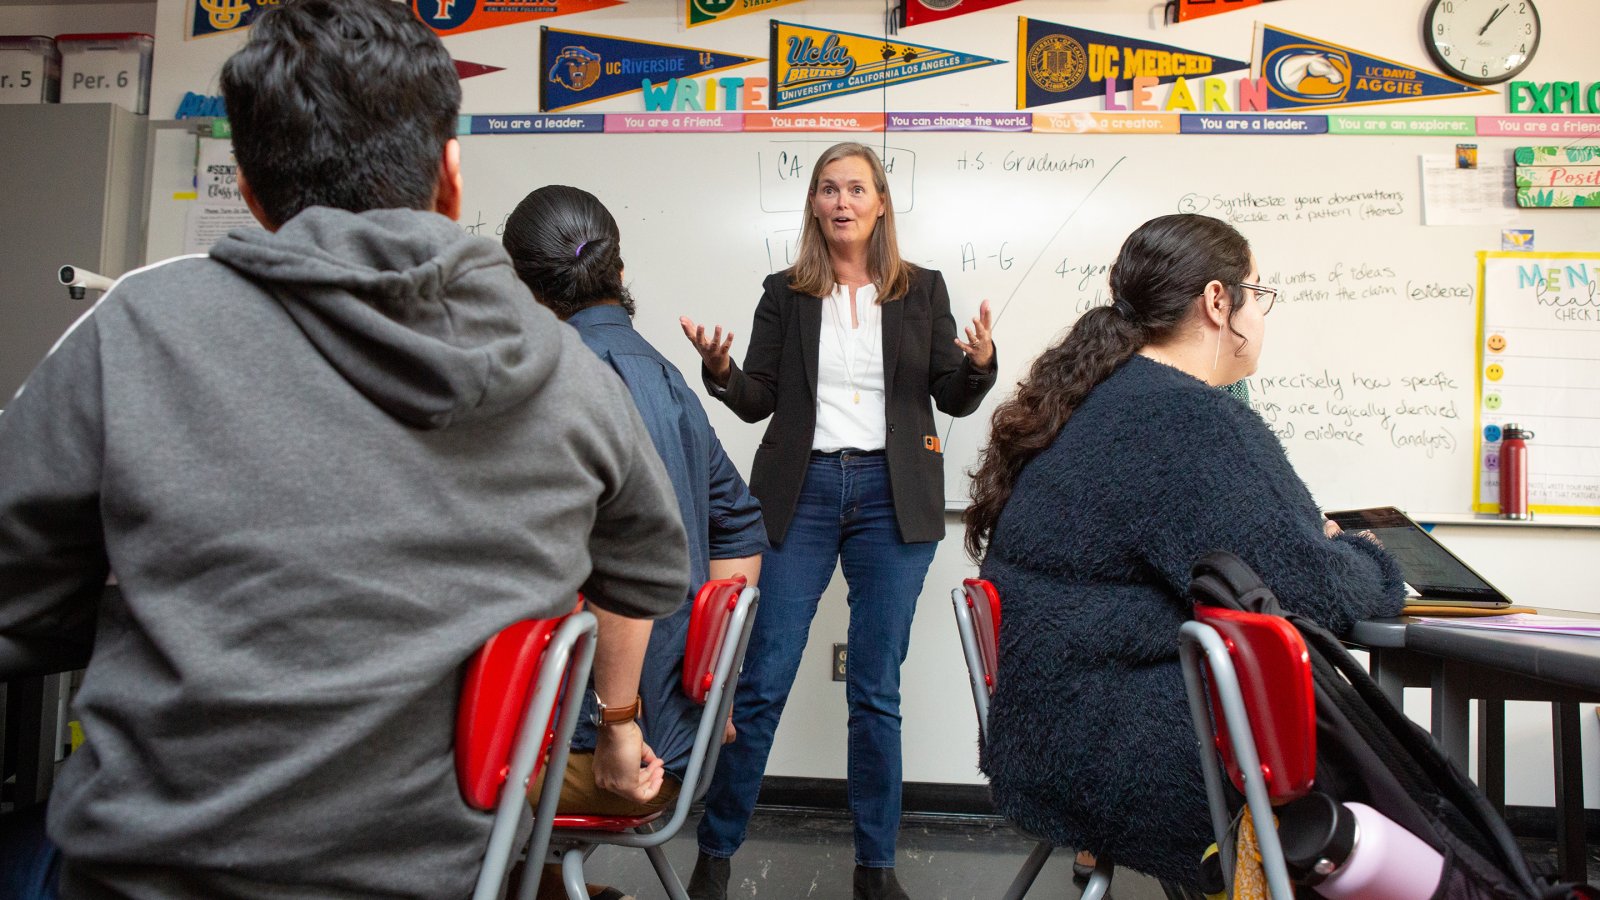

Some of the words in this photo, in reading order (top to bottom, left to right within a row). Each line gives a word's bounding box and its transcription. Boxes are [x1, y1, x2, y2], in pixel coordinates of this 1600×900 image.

[1442, 2, 1453, 13] 10
[1519, 3, 1526, 14] 2
[1438, 24, 1444, 35] 9
[1525, 23, 1532, 35] 3
[1520, 44, 1526, 55] 4
[901, 61, 919, 75] LOS
[920, 56, 961, 71] ANGELES
[1088, 43, 1120, 83] UC
[1123, 47, 1213, 80] MERCED
[1460, 59, 1467, 71] 7
[788, 67, 847, 83] BRUINS
[1481, 65, 1488, 76] 6
[20, 71, 32, 88] 5
[73, 72, 110, 90] Per.
[117, 71, 128, 88] 6
[1355, 77, 1424, 96] AGGIES
[641, 76, 769, 112] WRITE
[1104, 76, 1269, 112] LEARN
[488, 118, 508, 130] You
[511, 119, 531, 129] are
[534, 118, 542, 129] a
[545, 117, 585, 129] leader.
[624, 117, 645, 128] You
[648, 117, 669, 128] are
[672, 118, 680, 128] a
[683, 116, 724, 128] friend.
[771, 117, 793, 128] You
[794, 117, 816, 128] are
[819, 117, 860, 128] brave.
[891, 116, 909, 127] You
[912, 117, 931, 127] can
[933, 116, 972, 129] change
[974, 116, 993, 127] the
[995, 116, 1028, 127] world.
[1049, 118, 1071, 129] You
[1100, 119, 1109, 129] a
[1112, 117, 1163, 130] creator.
[1200, 118, 1222, 130] You
[1225, 119, 1249, 130] are
[1251, 119, 1261, 130] a
[1263, 118, 1308, 130] leader.
[1338, 118, 1361, 130] You
[1364, 119, 1387, 130] are
[1390, 119, 1407, 130] an
[1409, 119, 1469, 133] explorer.
[1498, 120, 1520, 132] You
[1523, 121, 1547, 132] are
[1550, 121, 1559, 132] a
[1003, 150, 1095, 173] Graduation
[1554, 308, 1592, 322] CHECK
[1260, 369, 1344, 401] precisely
[1288, 402, 1319, 415] are
